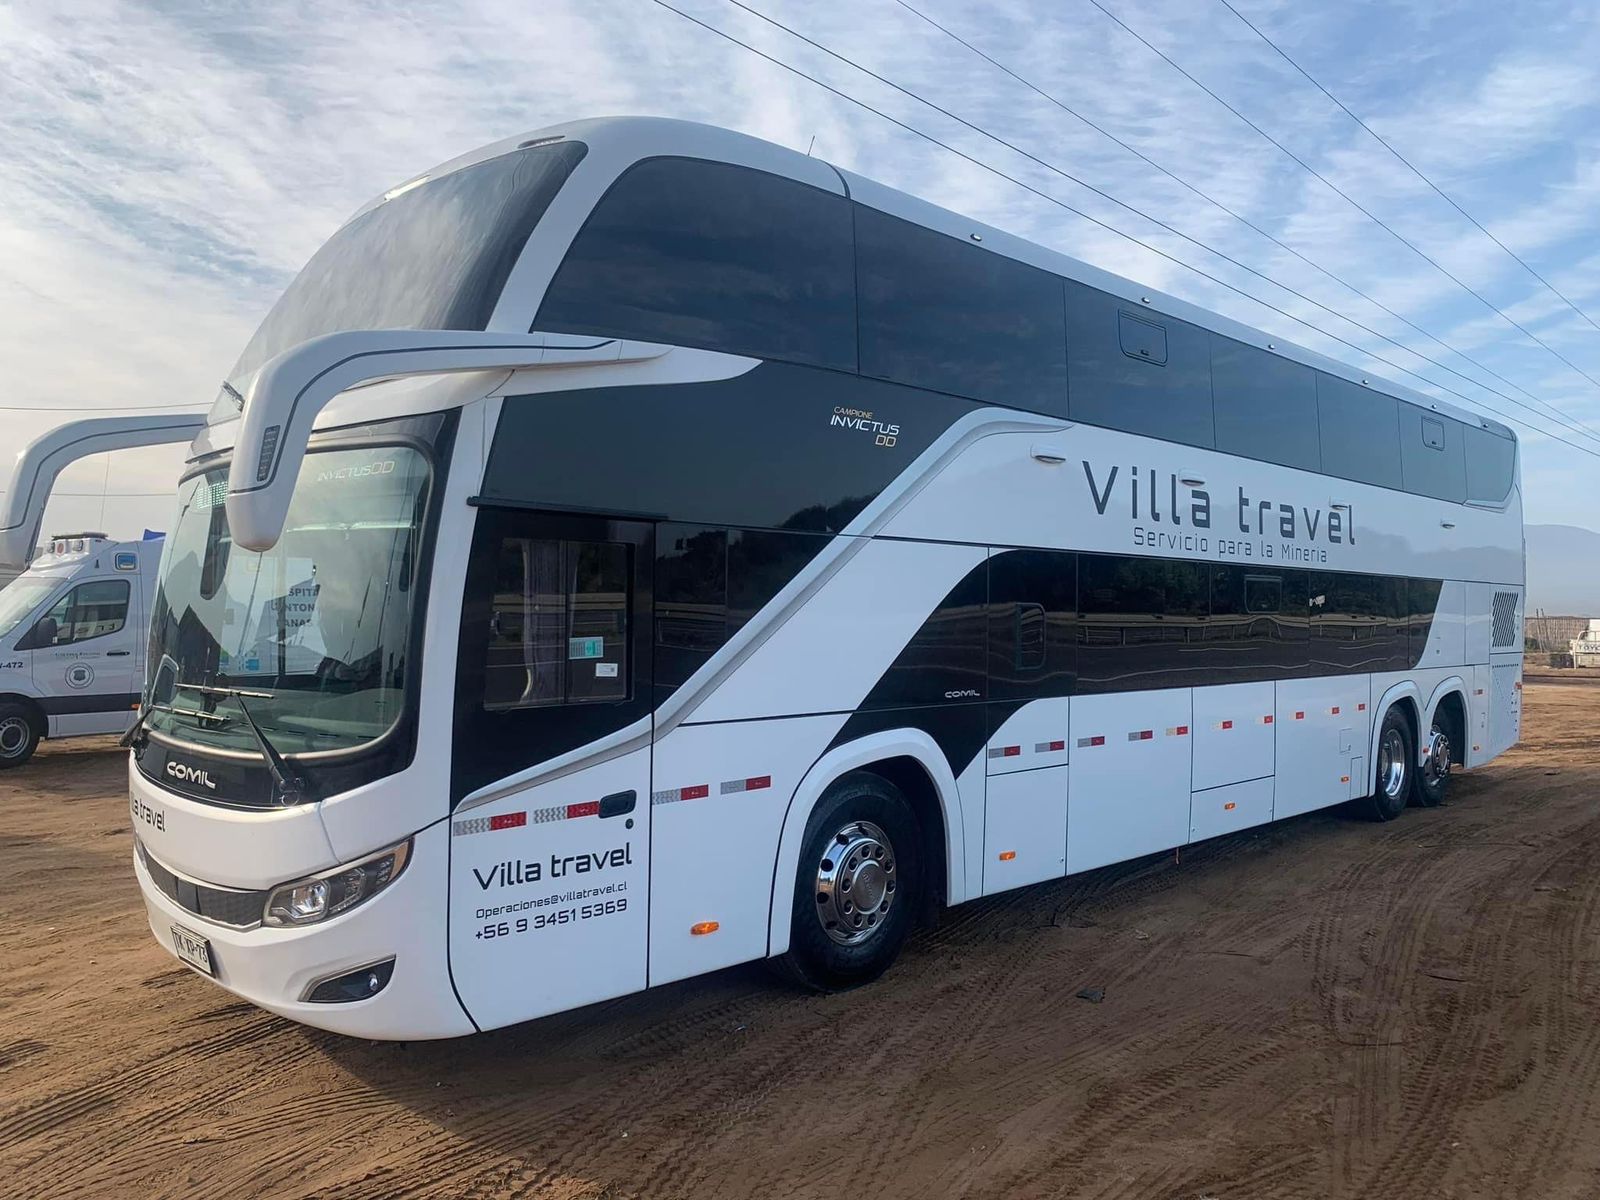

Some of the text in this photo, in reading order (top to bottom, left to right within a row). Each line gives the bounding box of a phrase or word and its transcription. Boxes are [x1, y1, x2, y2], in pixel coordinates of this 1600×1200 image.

[830, 414, 900, 436] INVICTUS
[833, 406, 873, 420] CAMPIONE
[1081, 460, 1356, 546] Villa travel
[1133, 527, 1209, 553] Servicio
[1218, 538, 1253, 558] para
[1260, 546, 1274, 558] la
[944, 689, 981, 699] COMIL
[167, 761, 216, 789] COMIL
[139, 799, 166, 833] travel
[472, 842, 633, 891] Villa travel
[476, 881, 627, 919] Operaciones@villatravel.cl
[475, 898, 628, 940] +56 9 3451 5369
